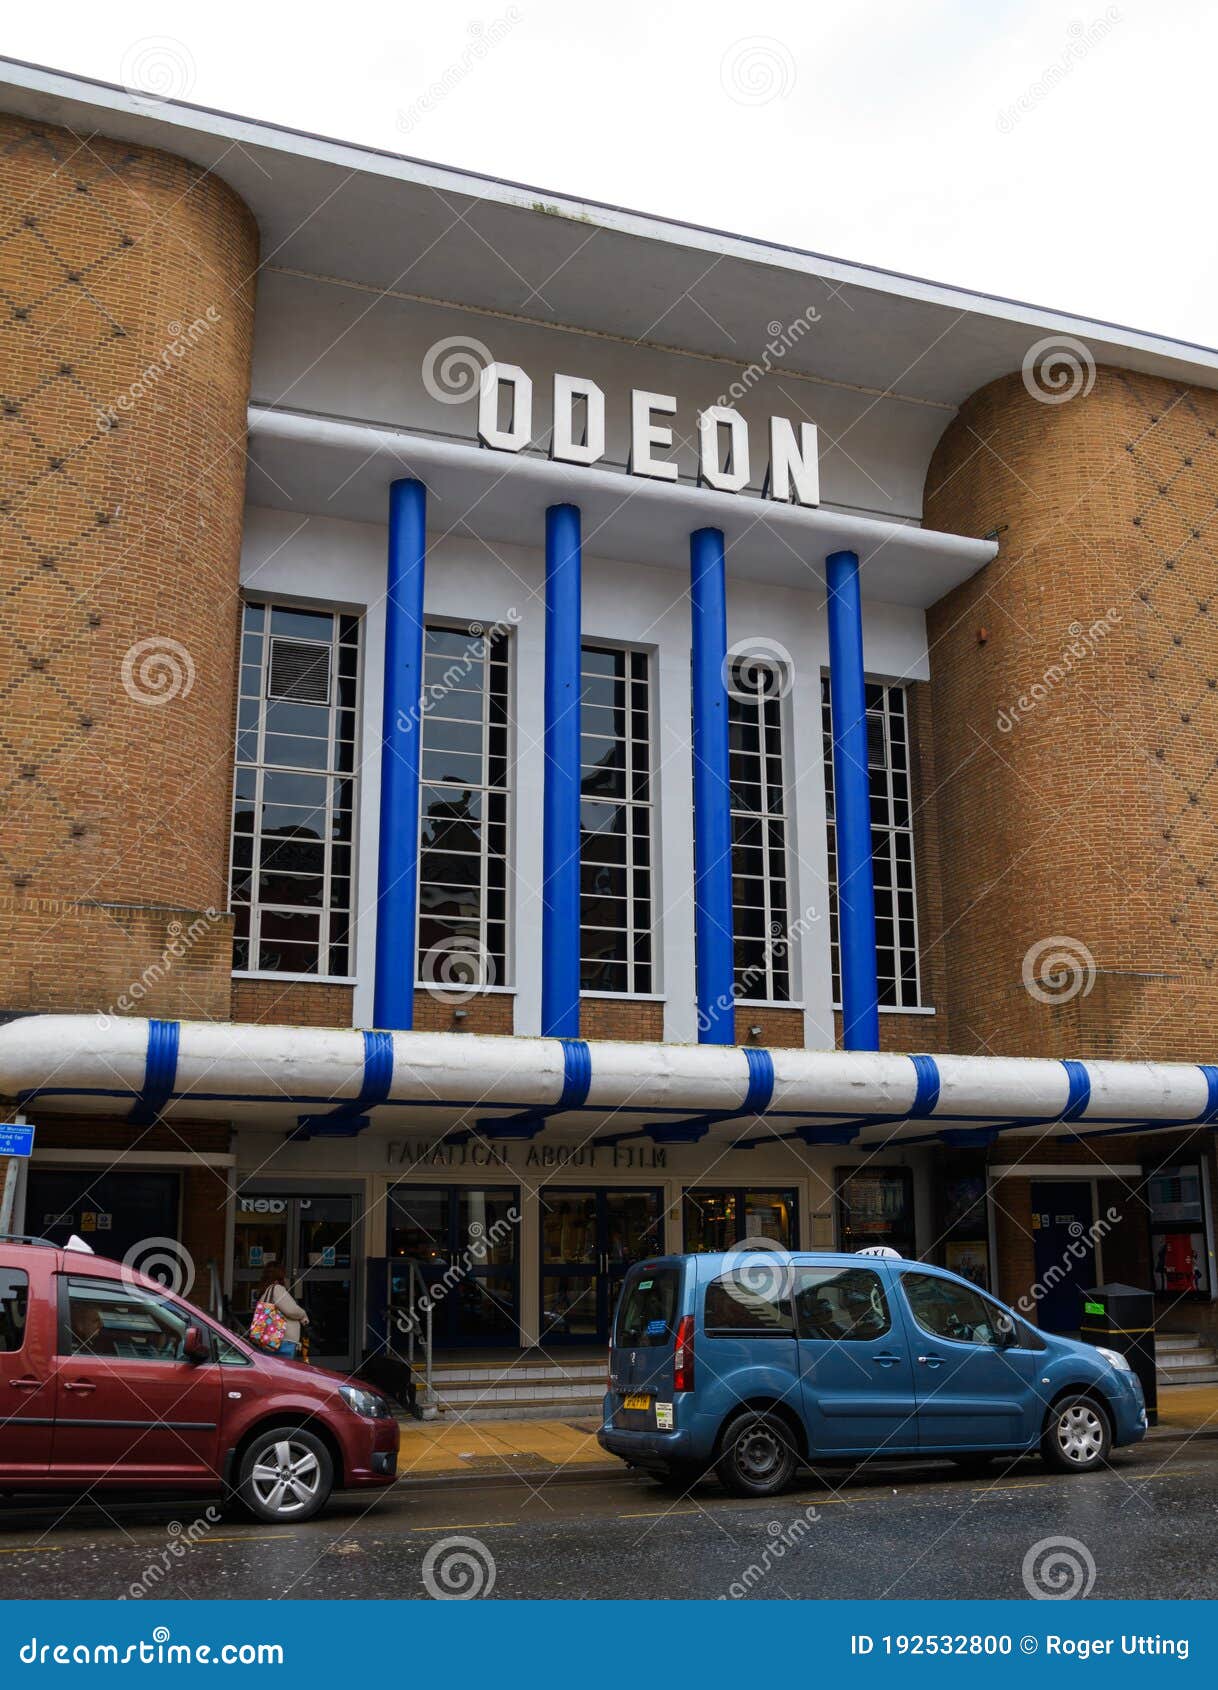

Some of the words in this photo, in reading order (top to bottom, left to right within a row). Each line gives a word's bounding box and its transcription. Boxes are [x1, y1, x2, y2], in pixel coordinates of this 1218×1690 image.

[478, 361, 820, 509] ODEON
[386, 1140, 511, 1167] FANATICAL
[526, 1144, 597, 1168] ABOUT
[612, 1146, 668, 1169] FILM
